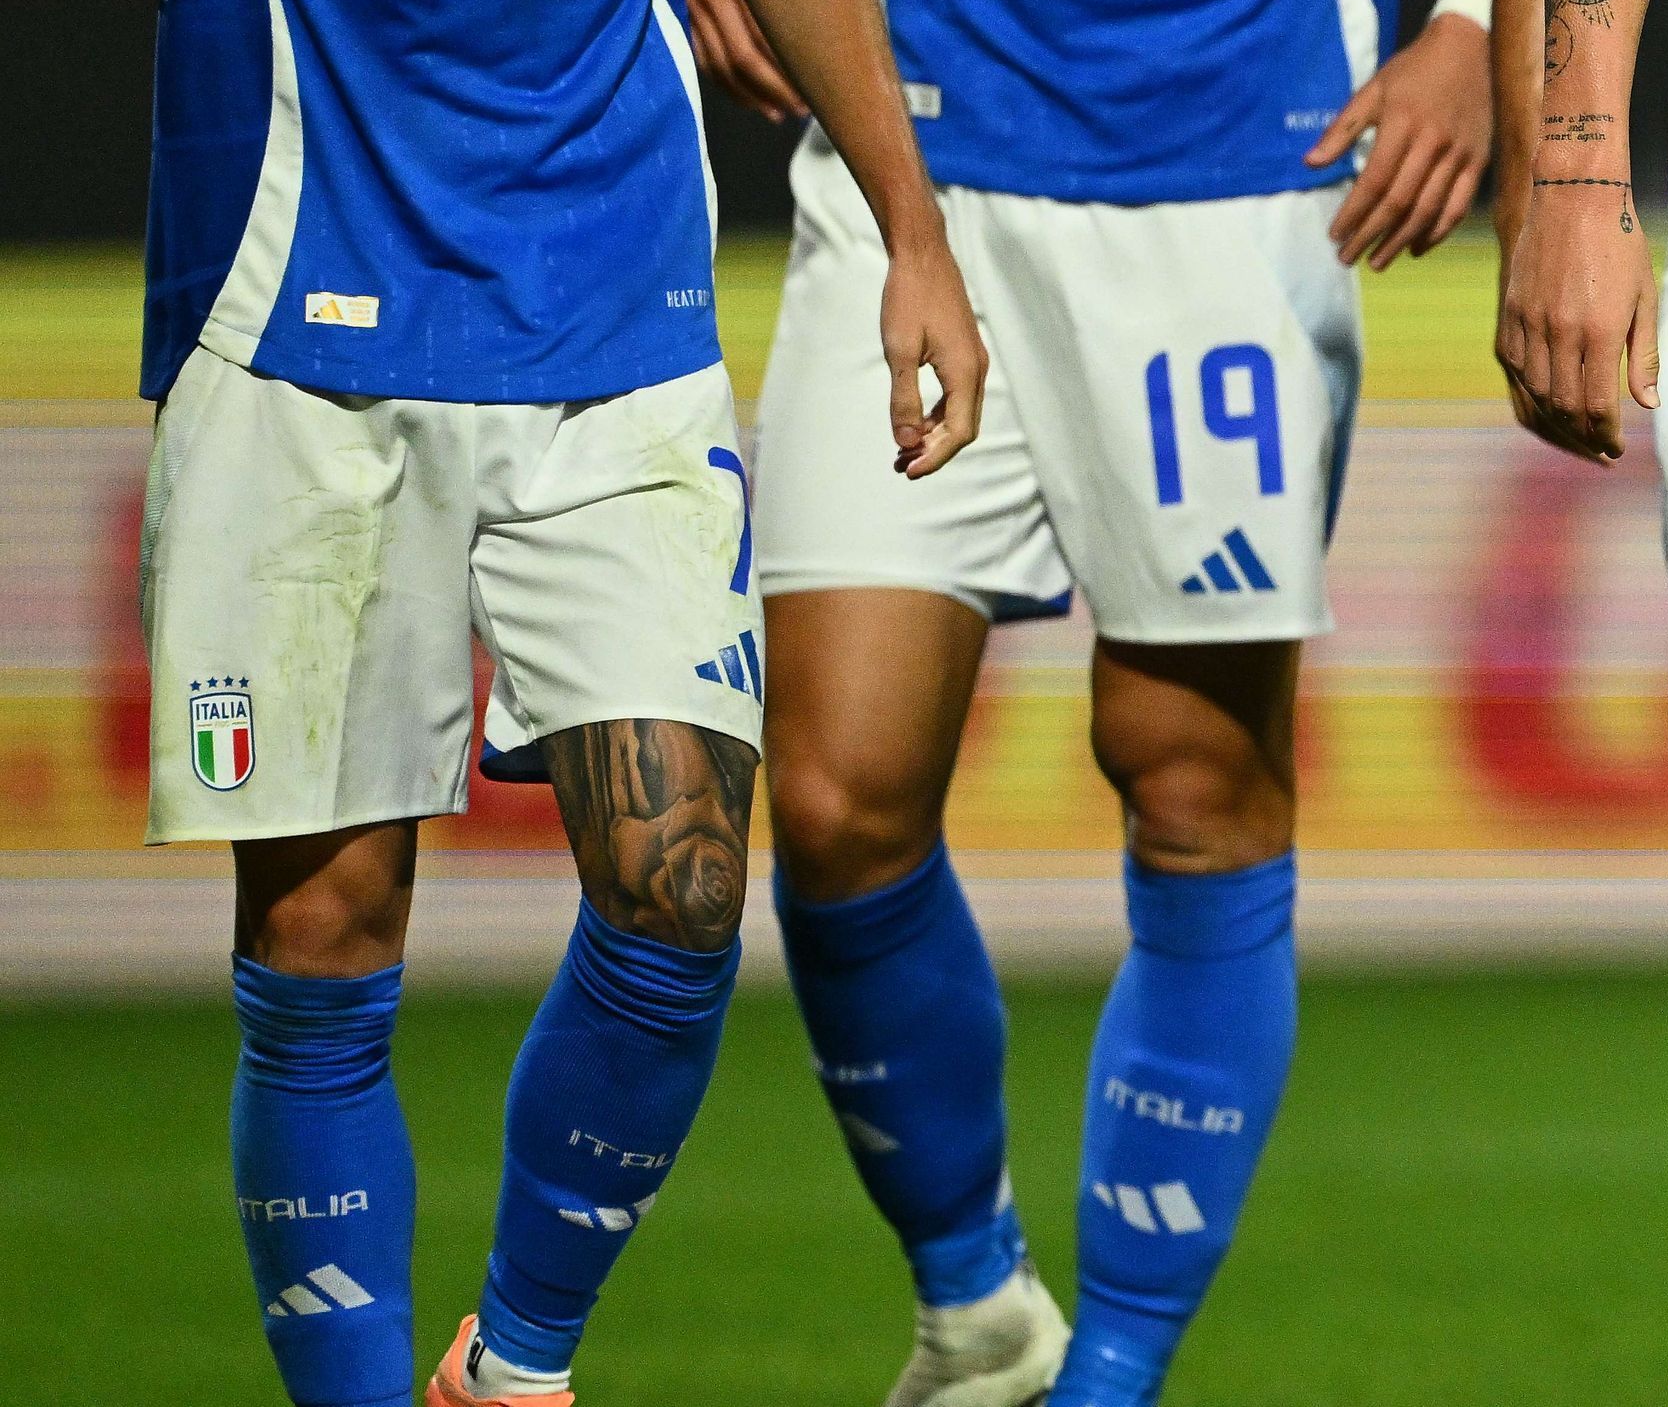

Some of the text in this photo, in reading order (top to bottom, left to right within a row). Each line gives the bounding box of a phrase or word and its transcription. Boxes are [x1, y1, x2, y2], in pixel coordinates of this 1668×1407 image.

[1544, 133, 1572, 141] start
[1145, 343, 1284, 506] 19
[195, 700, 248, 721] ITALIA
[1106, 1076, 1244, 1135] ITALIA
